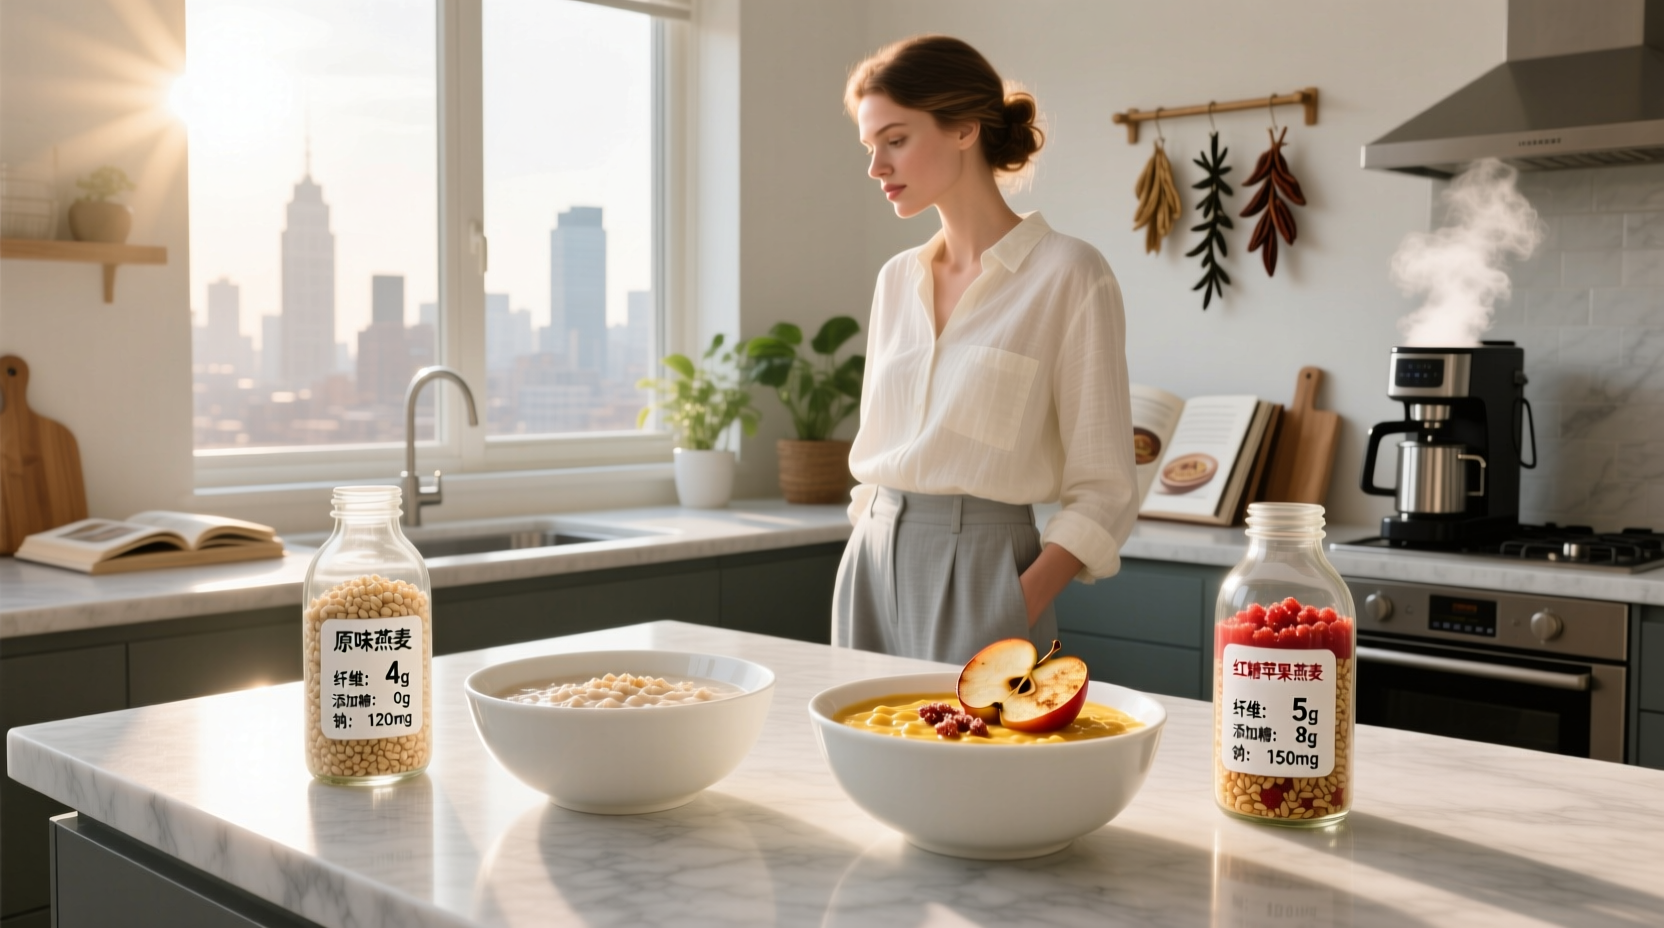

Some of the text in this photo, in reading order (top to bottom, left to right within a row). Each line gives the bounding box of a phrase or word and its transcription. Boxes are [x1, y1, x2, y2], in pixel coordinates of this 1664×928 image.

[333, 627, 412, 653] 原味燕麦
[385, 660, 410, 687] 4g
[393, 691, 411, 708] 0g
[1292, 697, 1319, 725] 5g
[367, 712, 412, 727] 120mg
[1295, 725, 1318, 748] 8g
[1267, 749, 1319, 769] 150mg
